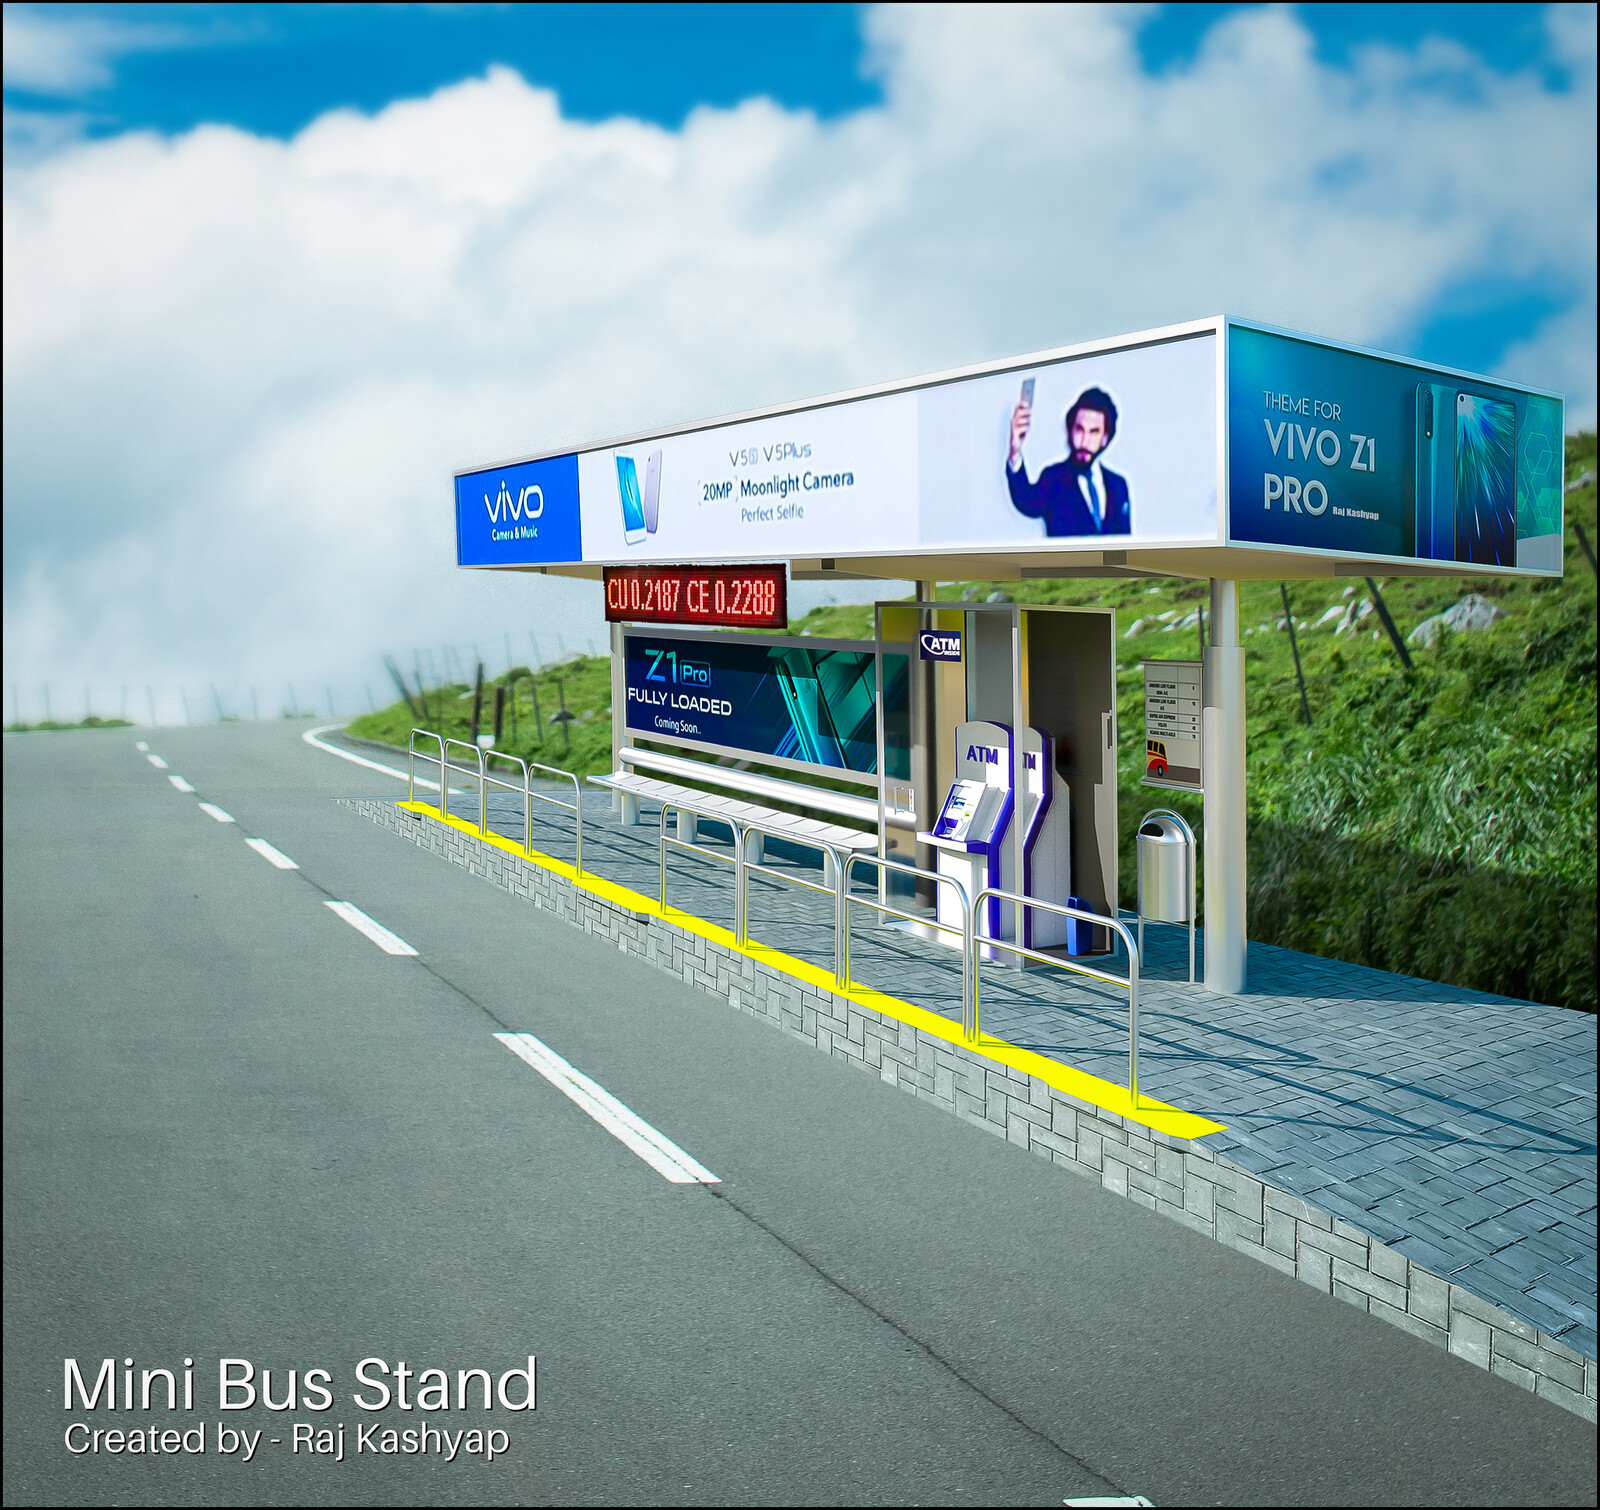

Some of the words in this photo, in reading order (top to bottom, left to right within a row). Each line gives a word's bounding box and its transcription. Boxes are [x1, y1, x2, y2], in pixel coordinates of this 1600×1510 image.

[1263, 391, 1310, 417] THEME
[1314, 400, 1342, 420] FOR
[1264, 418, 1342, 467] VIVO
[1349, 434, 1377, 473] Z1
[740, 473, 800, 499] Moonlight
[803, 471, 854, 491] Camera
[1264, 473, 1329, 516] PRO
[741, 505, 774, 523] Perfect
[776, 503, 804, 521] Selfie
[1332, 506, 1346, 517] Raj
[1346, 507, 1380, 521] Kashyap
[491, 528, 514, 542] Camera
[514, 526, 520, 540] &
[520, 524, 538, 540] Music
[686, 580, 709, 613] CE
[714, 580, 776, 616] 0.2288
[931, 637, 960, 651] ATM
[645, 649, 677, 684] Z1
[682, 664, 708, 683] Pro
[628, 686, 668, 706] FULLY
[670, 692, 733, 716] LOADED
[654, 715, 680, 734] Coming
[966, 744, 998, 765] ATM
[1022, 752, 1036, 770] TM
